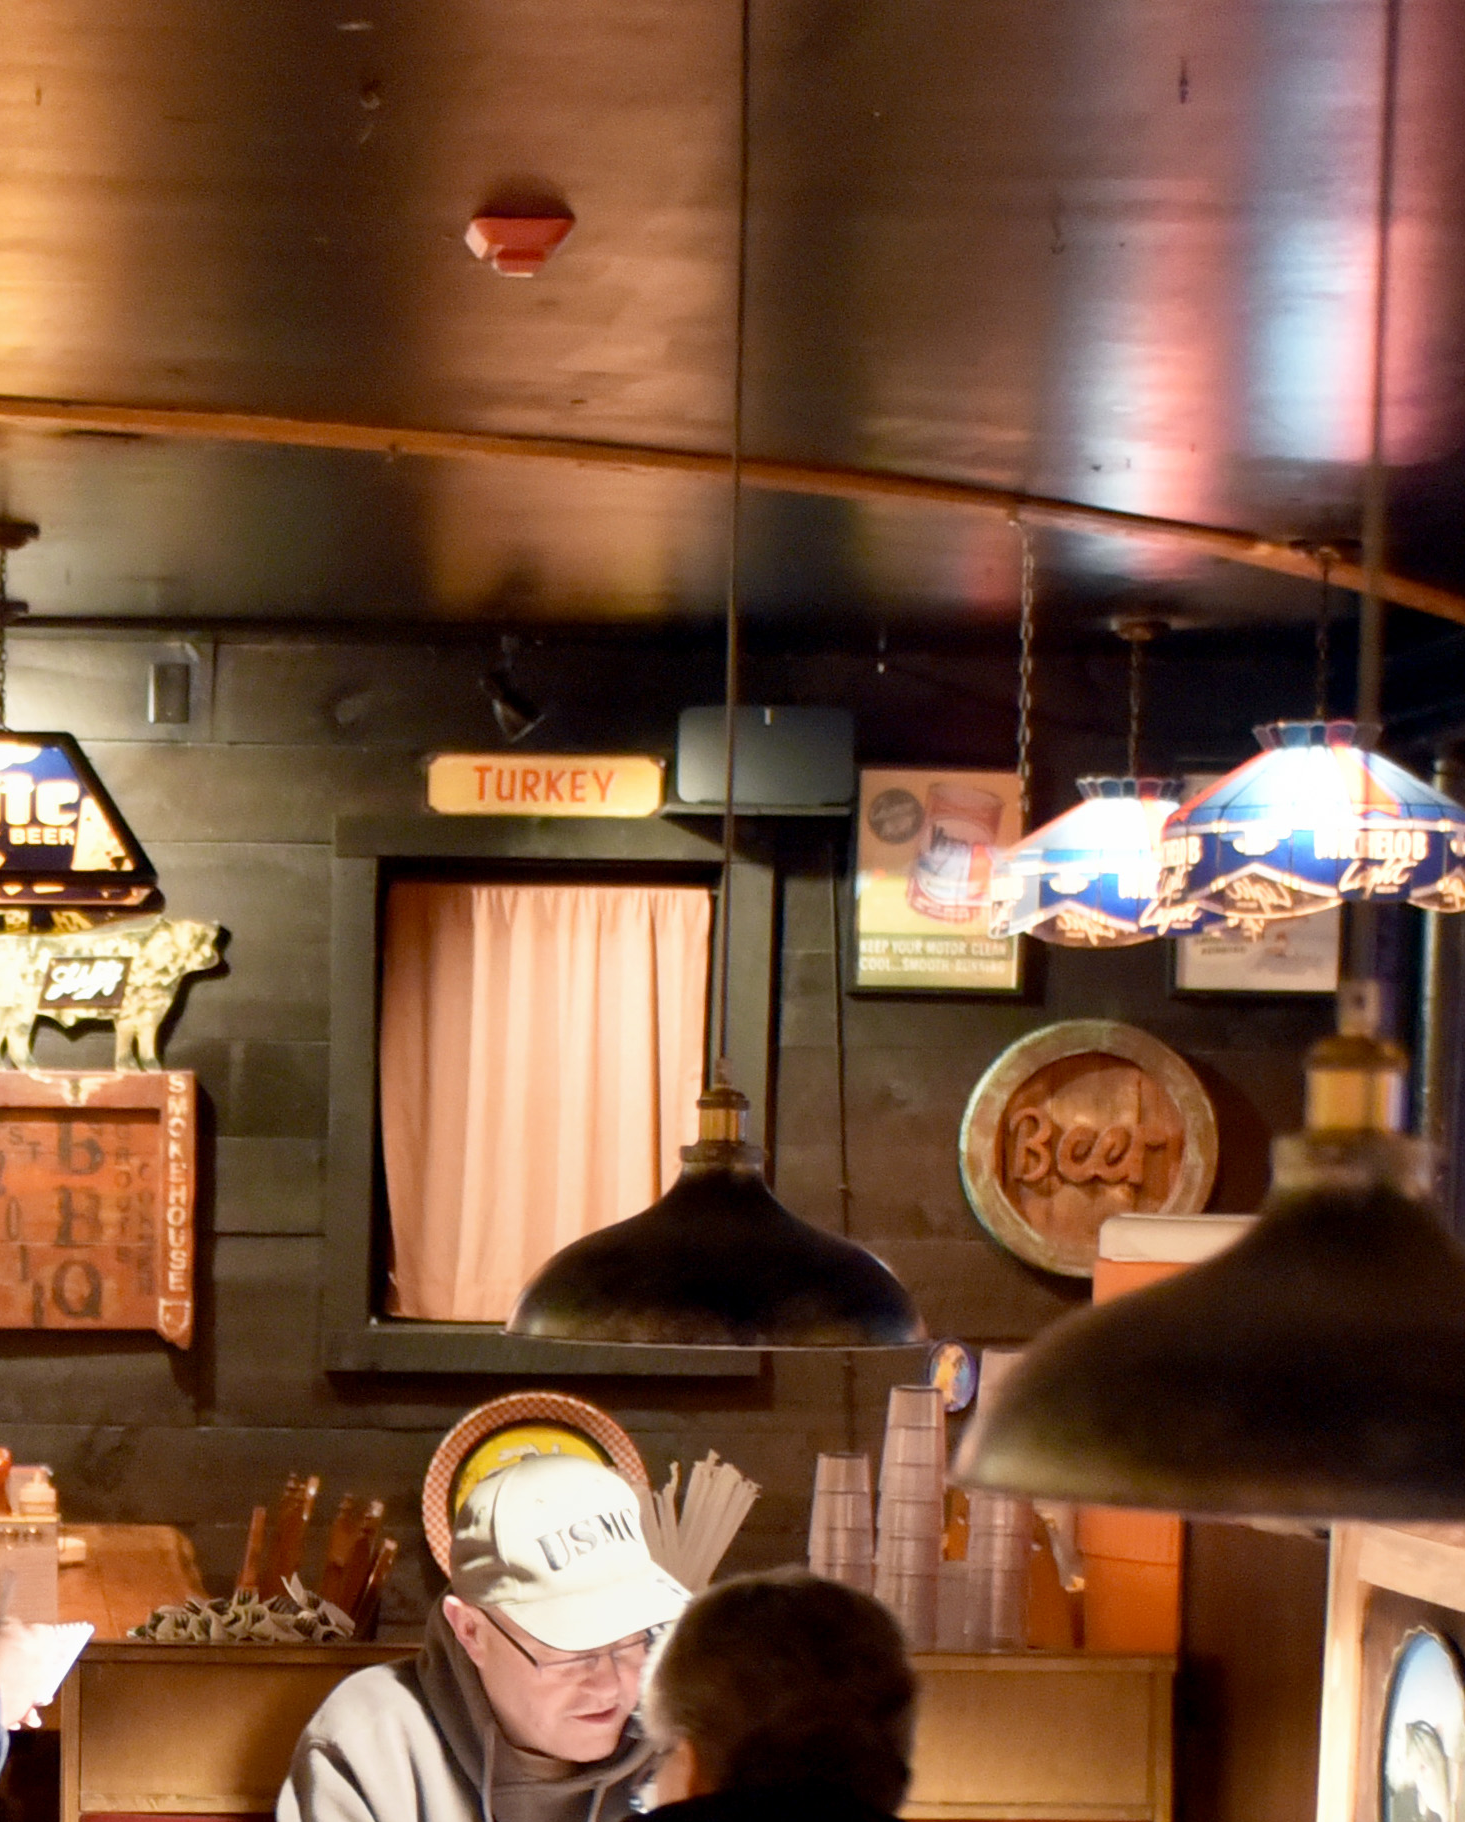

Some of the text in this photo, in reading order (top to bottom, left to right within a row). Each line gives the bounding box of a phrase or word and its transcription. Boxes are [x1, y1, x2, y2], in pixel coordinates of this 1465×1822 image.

[473, 765, 614, 803] TURKEY
[8, 827, 75, 845] BEER
[1009, 1106, 1167, 1184] Beer
[166, 1074, 187, 1292] SMOKEHOUSE
[535, 1508, 640, 1572] USMC
